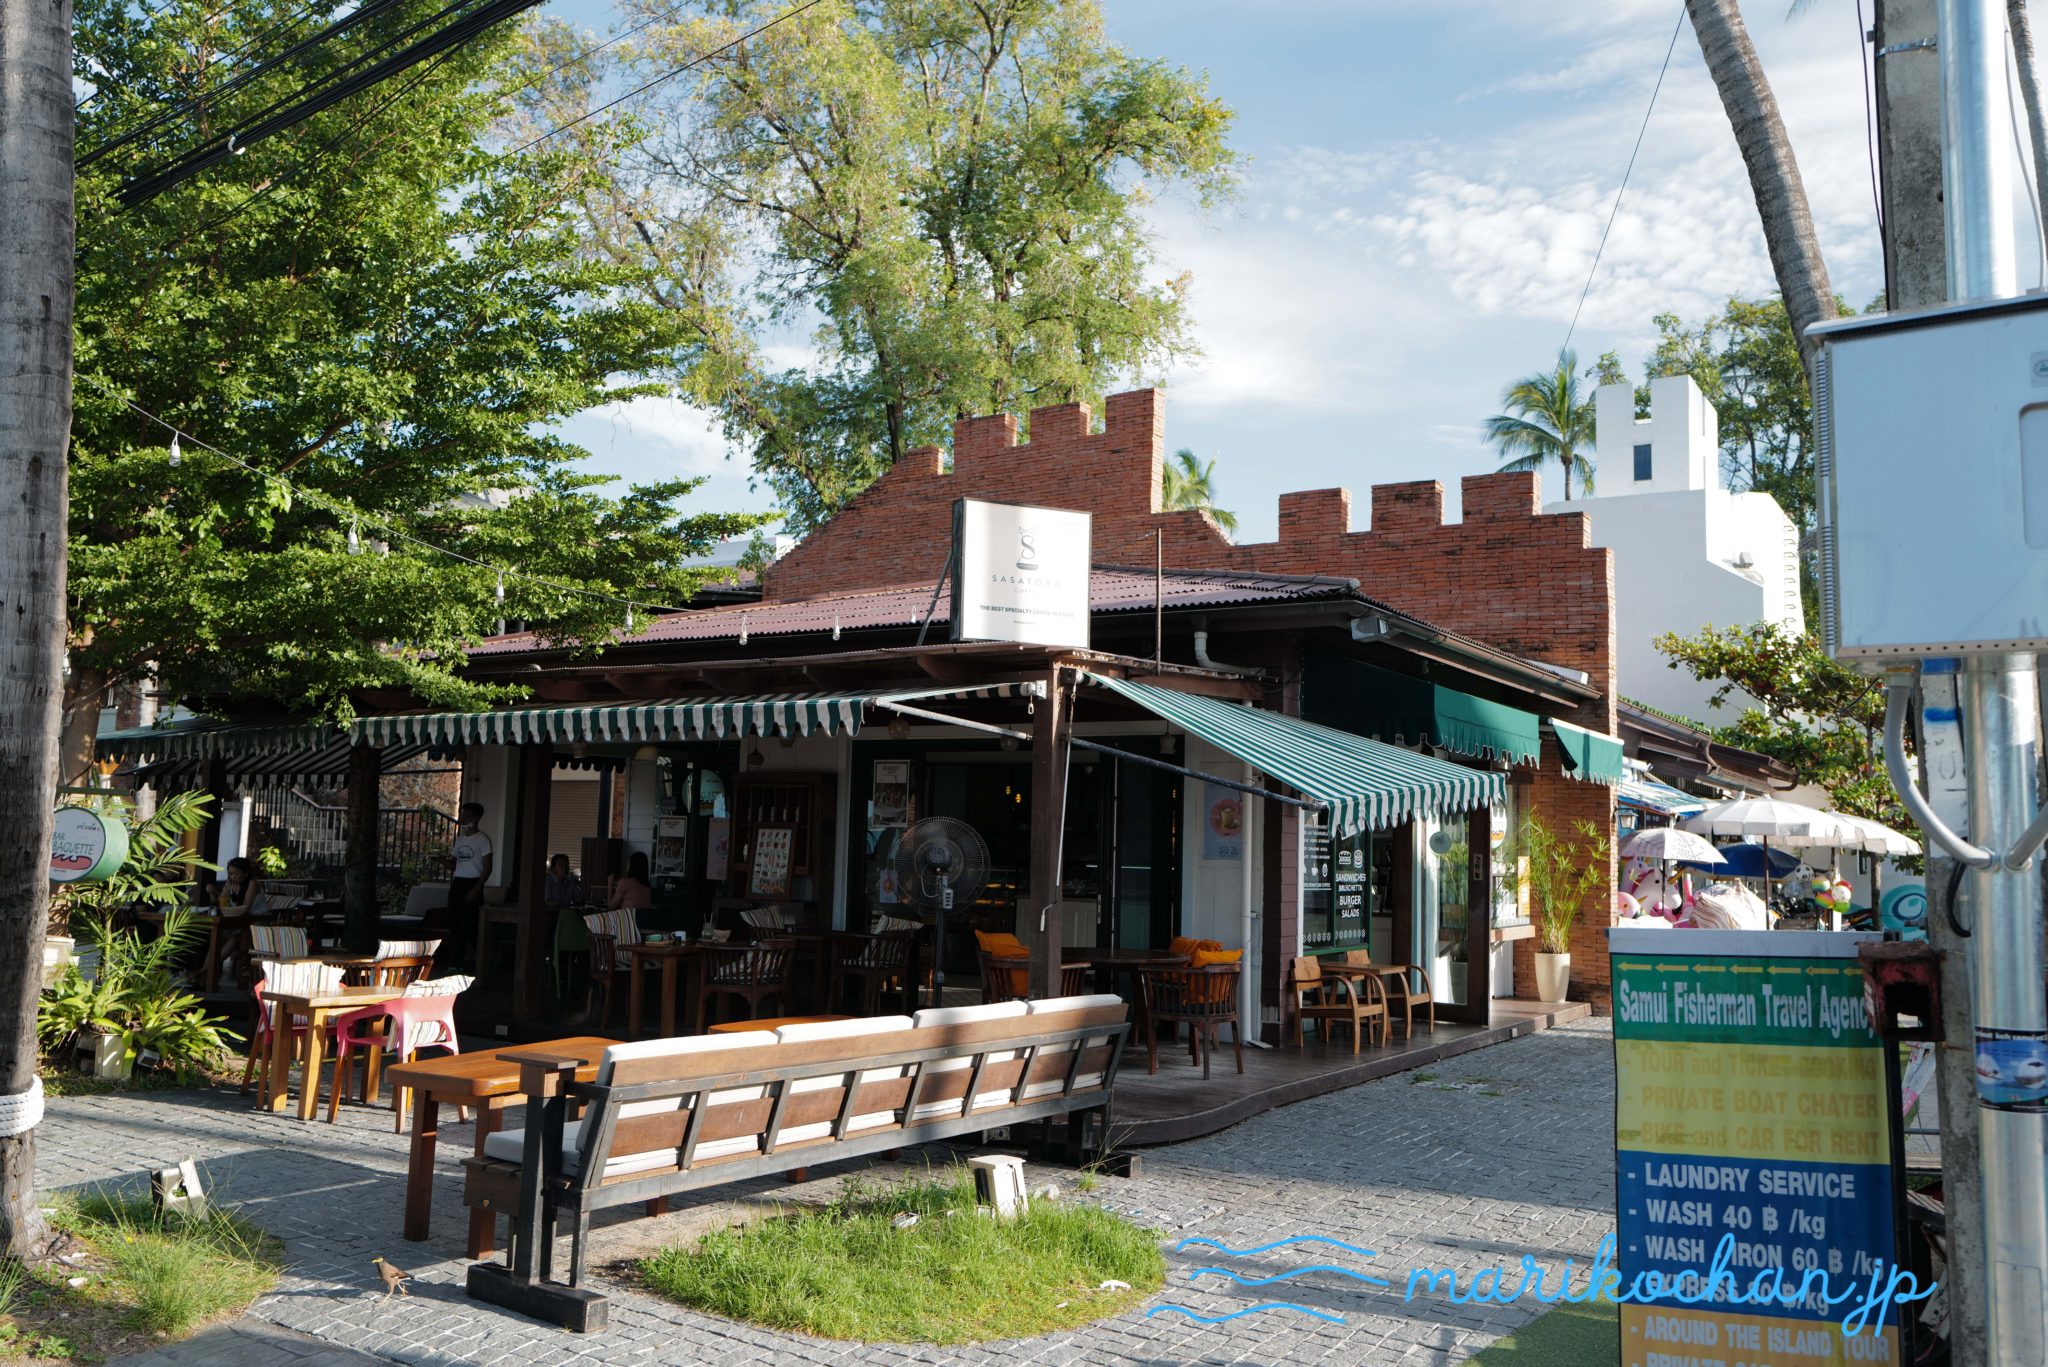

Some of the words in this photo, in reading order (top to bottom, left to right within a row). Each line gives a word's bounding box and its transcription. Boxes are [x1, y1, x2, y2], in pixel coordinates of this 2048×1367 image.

[1005, 606, 1032, 614] SPECIALTY
[52, 832, 65, 840] BAR
[52, 841, 95, 856] BAGUETTE
[1335, 872, 1367, 882] SANDWICHES
[1339, 894, 1362, 906] BURGER
[1341, 908, 1360, 918] SALADS
[1619, 979, 1668, 1023] Samui
[1674, 981, 1756, 1026] Fisherman
[1762, 983, 1812, 1028] Travel
[1640, 1050, 1686, 1074] TOUR
[1691, 1053, 1720, 1075] and
[1798, 1055, 1877, 1080] BOOKING
[1641, 1086, 1724, 1111] PRIVATE
[1733, 1089, 1786, 1114] BOAT
[1797, 1091, 1878, 1118] CHATER
[1641, 1121, 1686, 1143] BIKE
[1694, 1125, 1727, 1147] and
[1735, 1125, 1775, 1151] CAR
[1783, 1127, 1821, 1153] FOR
[1831, 1130, 1880, 1156] RENT
[1645, 1162, 1750, 1193] LAUNDRY
[1758, 1168, 1856, 1199] SERVICE
[1646, 1199, 1713, 1227] WASH
[1722, 1205, 1752, 1230] 40
[1789, 1212, 1826, 1240] /kg
[1645, 1235, 1705, 1264] WASH
[1731, 1241, 1783, 1270] IRON
[1791, 1247, 1819, 1272] 60
[1644, 1314, 1718, 1347] AROUND
[1725, 1323, 1761, 1351] THE
[1768, 1326, 1832, 1357] ISLAND
[1840, 1333, 1889, 1361] TOUR
